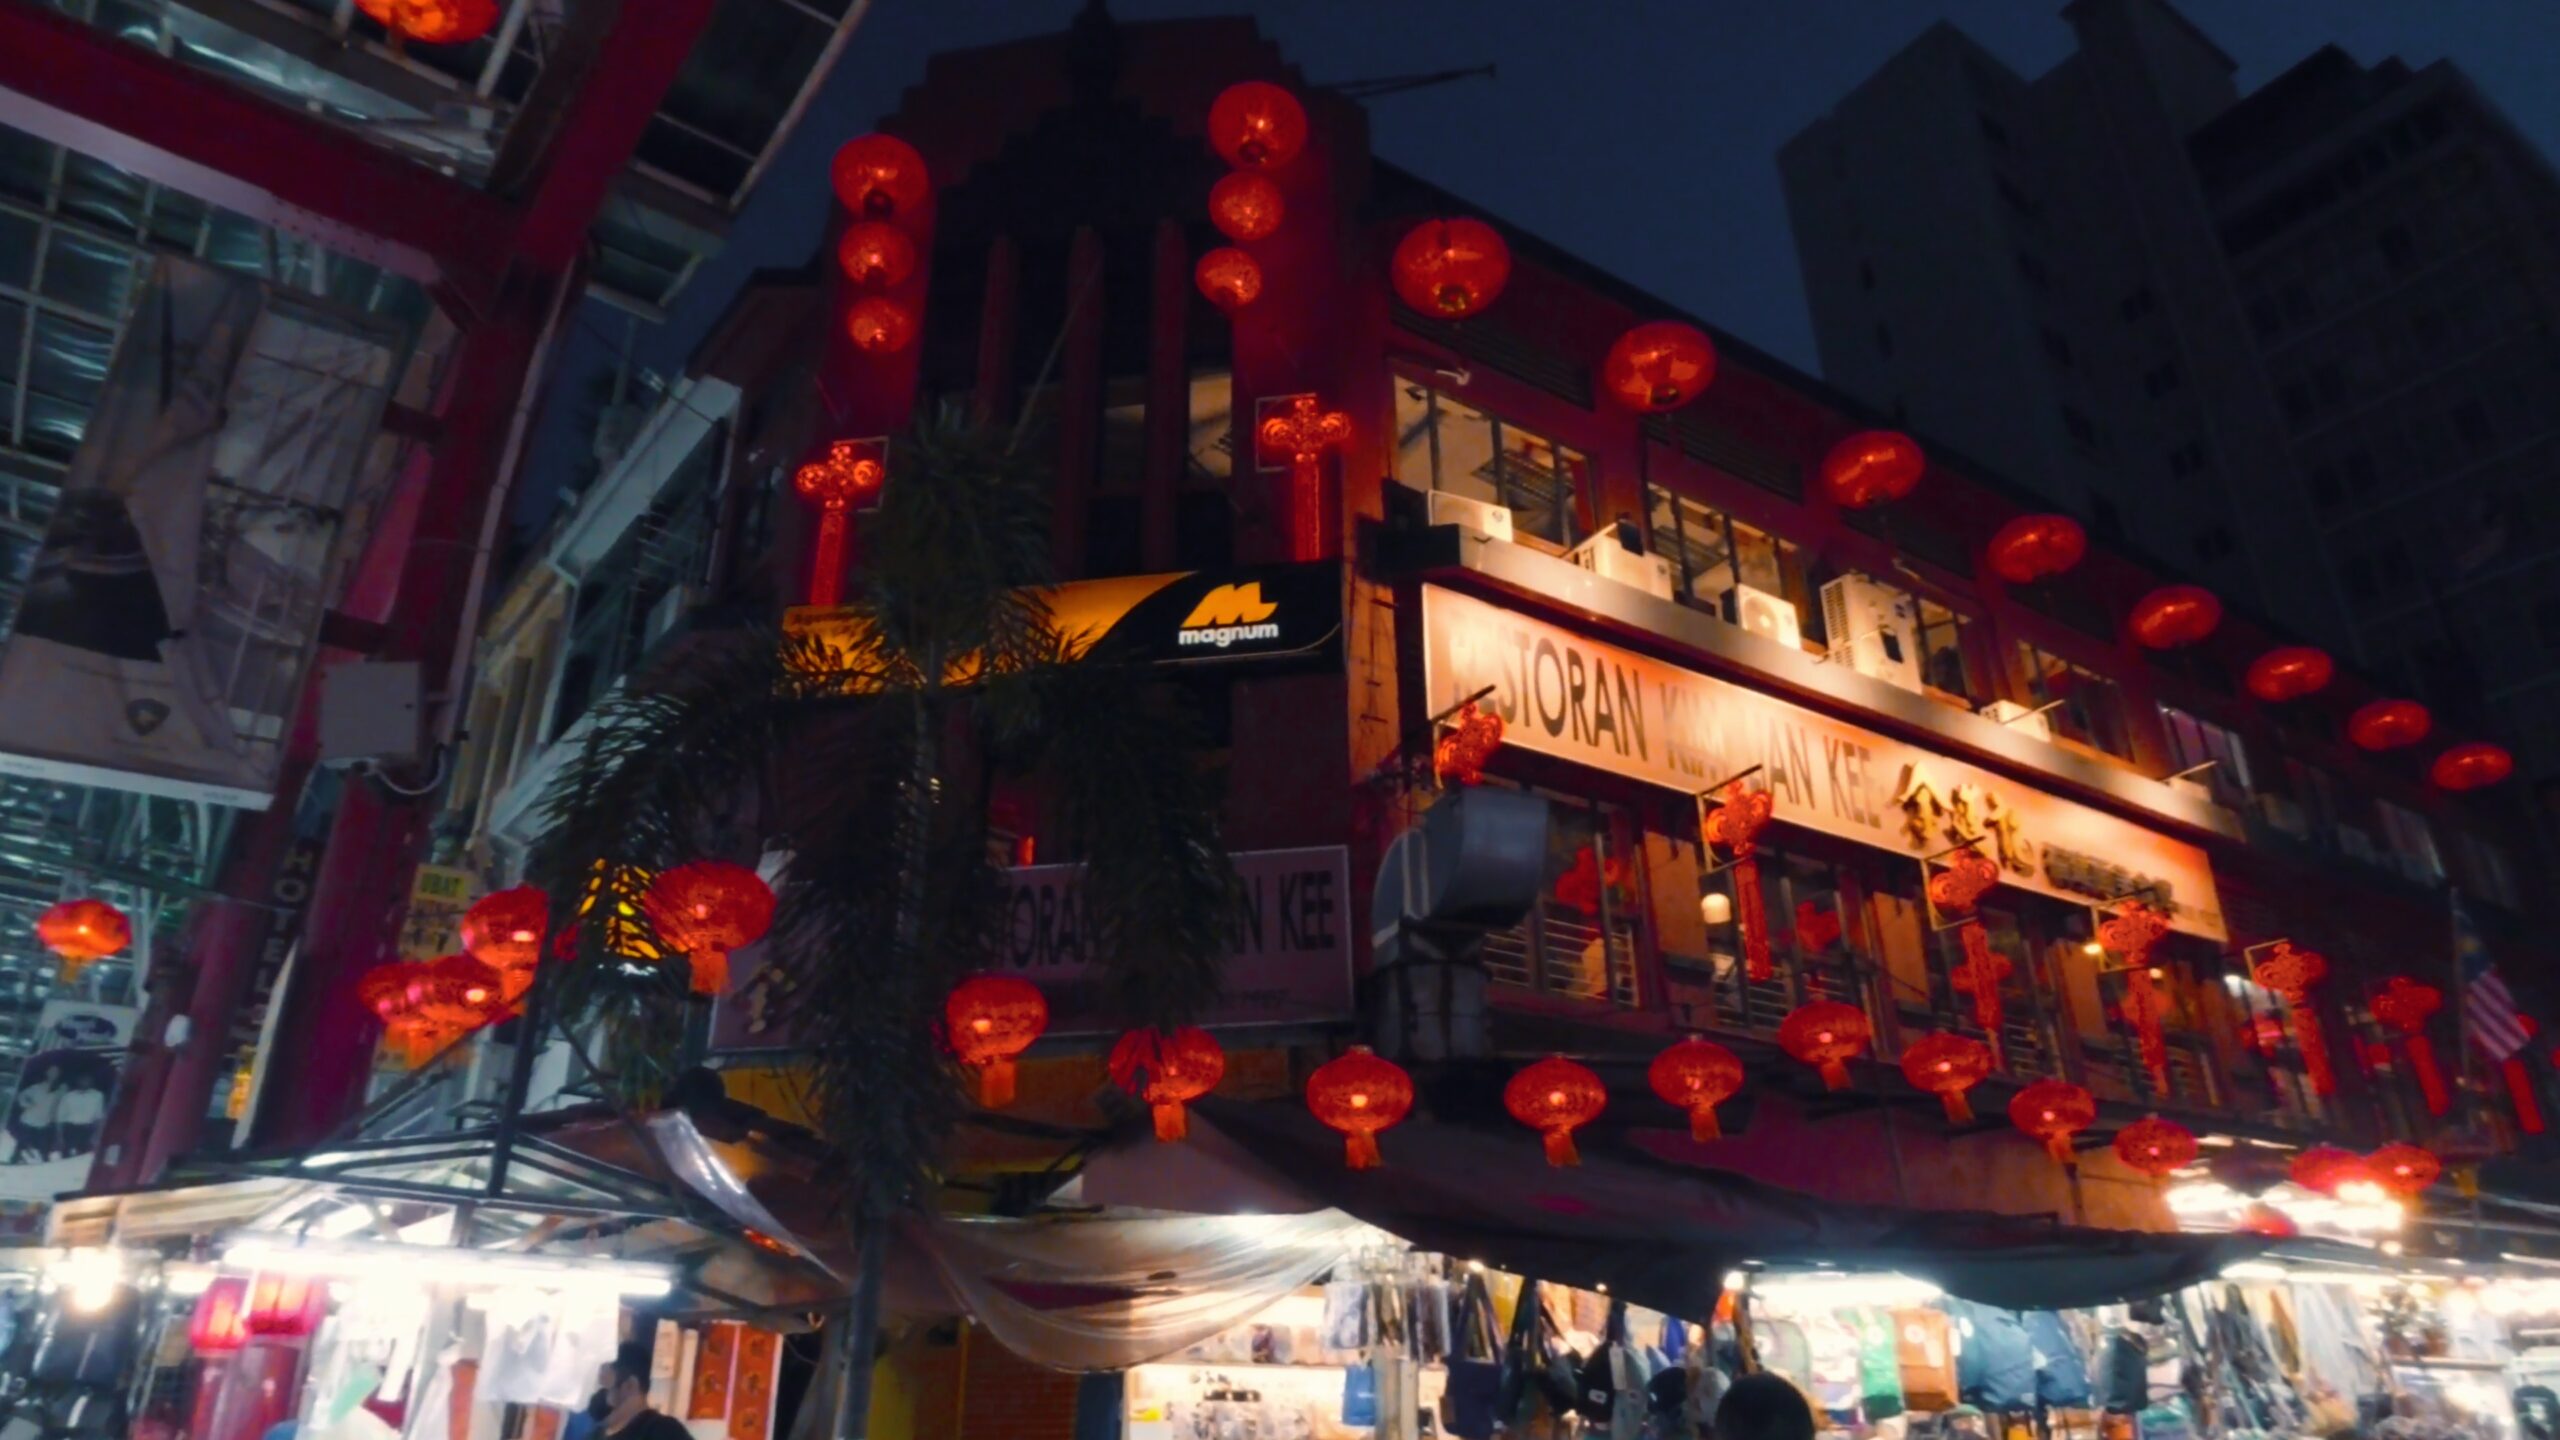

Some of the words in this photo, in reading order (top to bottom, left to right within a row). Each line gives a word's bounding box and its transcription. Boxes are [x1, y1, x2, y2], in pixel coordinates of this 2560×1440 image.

[1178, 623, 1279, 647] magnum
[1822, 735, 1882, 830] KEE
[1279, 869, 1336, 950] KEE
